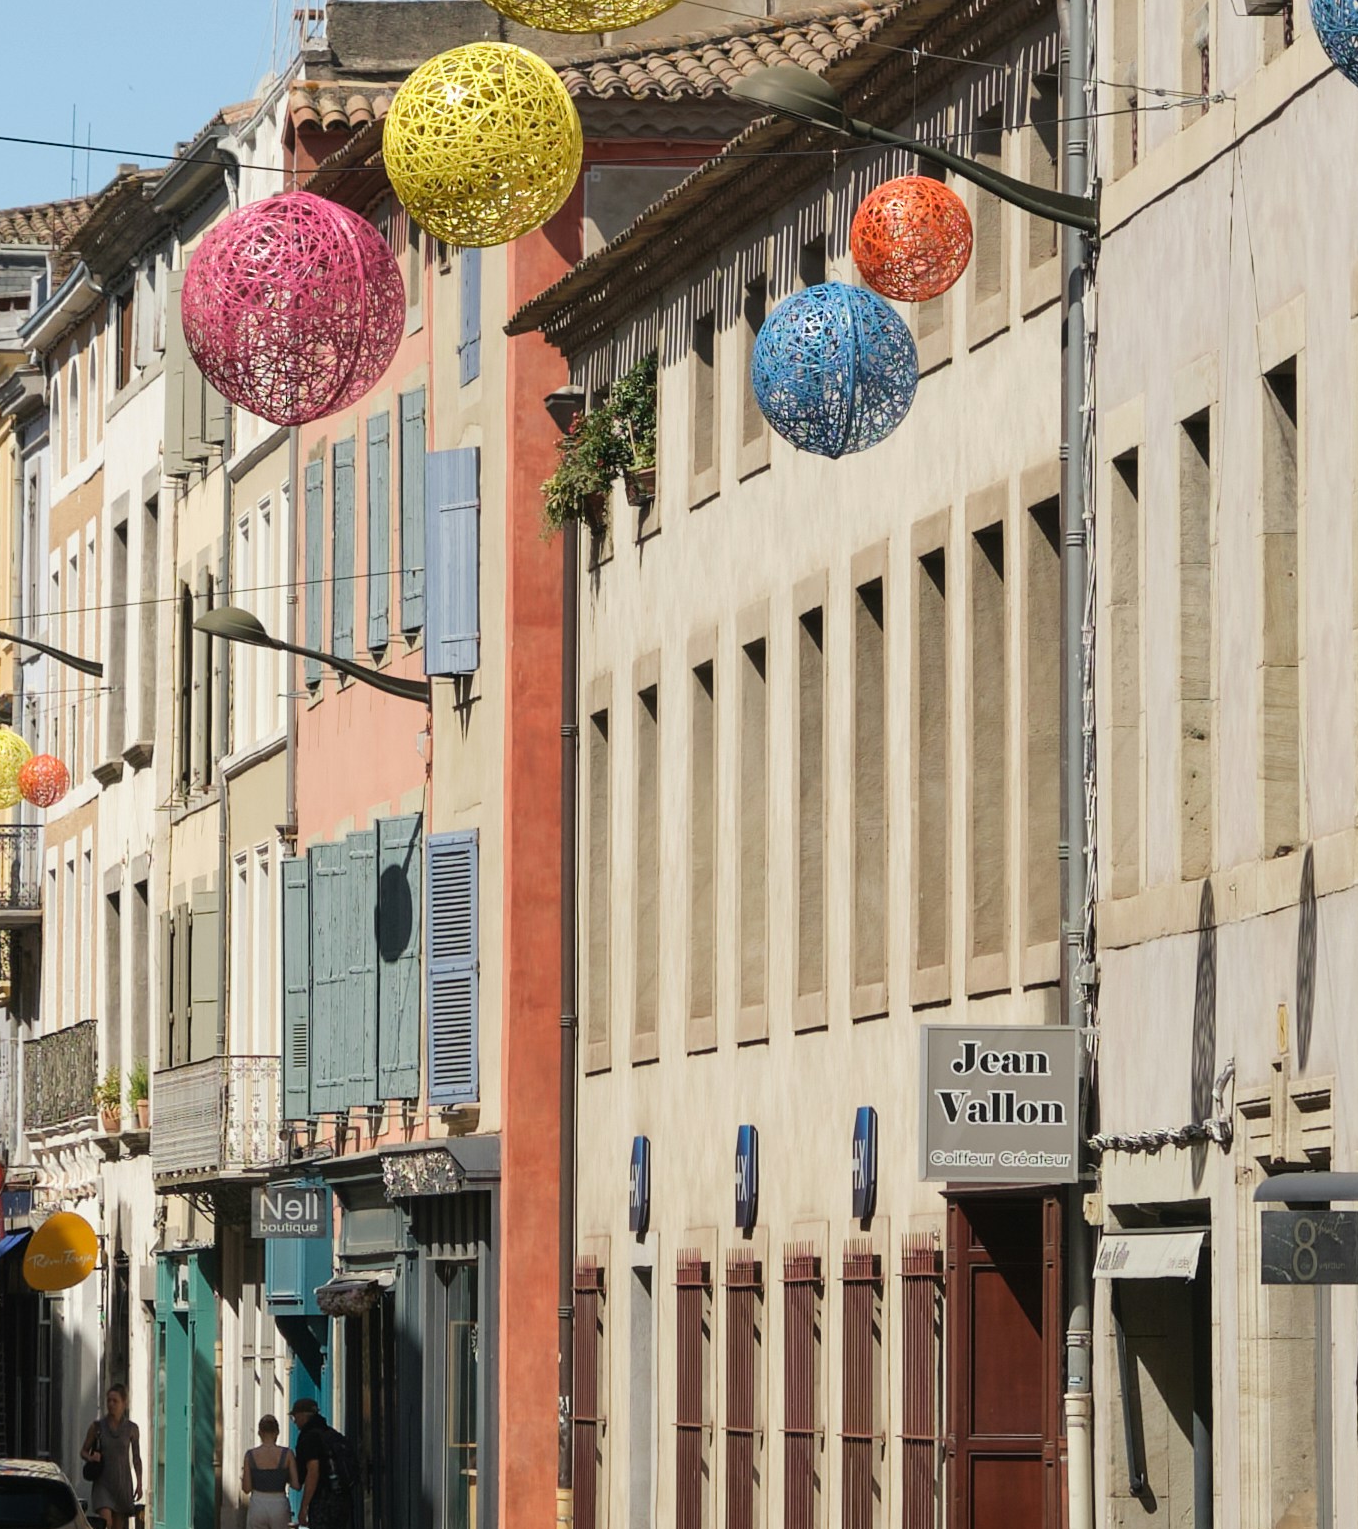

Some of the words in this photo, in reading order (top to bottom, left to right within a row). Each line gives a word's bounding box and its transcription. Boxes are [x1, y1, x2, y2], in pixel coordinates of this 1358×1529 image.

[951, 1040, 1052, 1075] Jean
[934, 1089, 1067, 1125] Vallon
[929, 1149, 995, 1166] Coiffeur
[999, 1149, 1071, 1166] Créateur
[261, 1193, 318, 1220] Nell
[260, 1221, 318, 1234] boutique
[1292, 1217, 1318, 1281] 8
